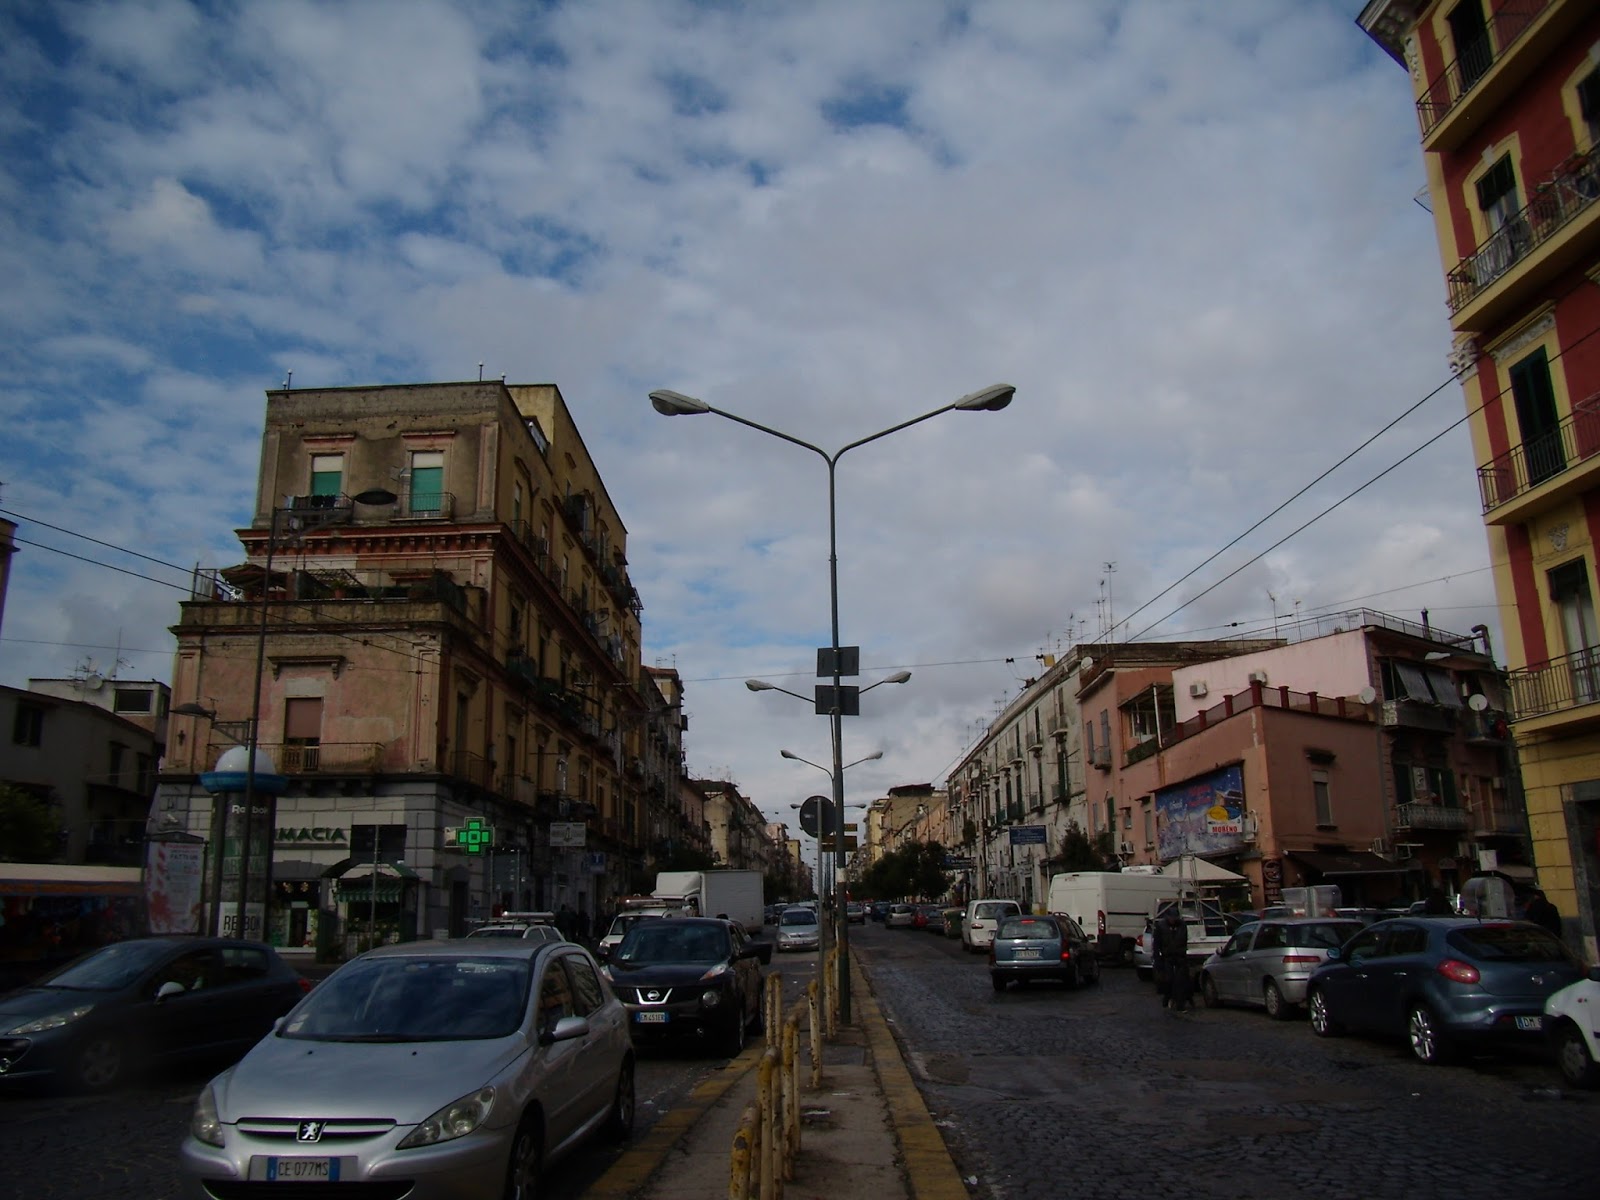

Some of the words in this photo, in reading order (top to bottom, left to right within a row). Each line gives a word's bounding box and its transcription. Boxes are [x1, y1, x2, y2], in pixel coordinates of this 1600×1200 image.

[232, 804, 268, 815] Rebok
[274, 827, 348, 842] MACIA
[1212, 825, 1237, 833] MORENO
